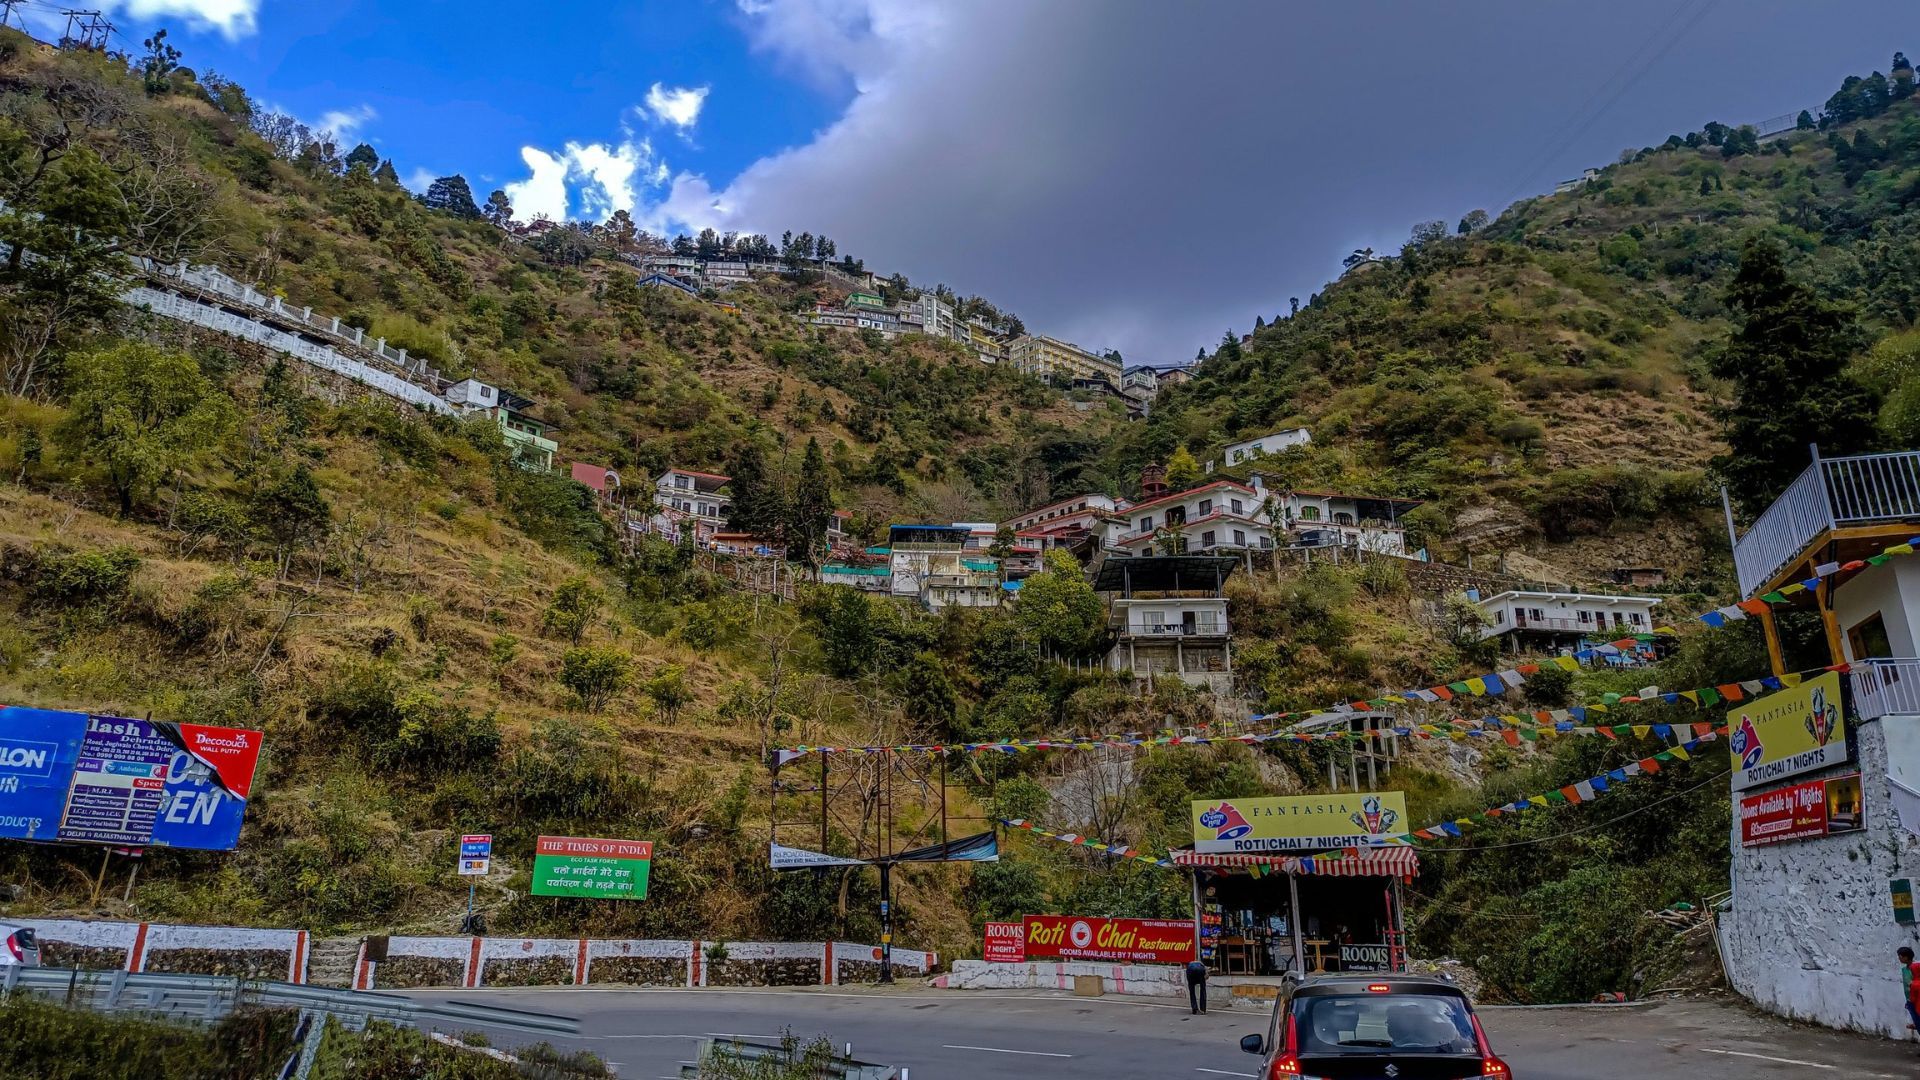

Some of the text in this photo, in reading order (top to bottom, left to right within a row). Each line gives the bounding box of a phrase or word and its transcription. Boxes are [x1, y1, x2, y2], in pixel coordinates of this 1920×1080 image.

[1756, 699, 1804, 725] FANTASIA
[87, 719, 140, 737] lash
[0, 747, 47, 768] LON
[220, 747, 242, 755] PUTTY
[1748, 748, 1825, 782] ROTI/CHAI 7 NIGHTS
[1253, 804, 1348, 817] FANTASIA
[542, 841, 647, 855] THE TIMES OF INDIA
[1234, 836, 1369, 850] ROTI/CHAI 7 NIGHTS
[583, 879, 593, 888] की
[987, 925, 1024, 938] ROOMS
[1028, 922, 1193, 951] Roti Chai Restaurant
[986, 945, 1017, 953] 7 NIGHTS
[1059, 948, 1082, 956] ROOMS
[1082, 950, 1116, 959] AVAILABLE
[1117, 951, 1127, 959] BY
[1132, 952, 1156, 960] NIGHTS
[1341, 946, 1389, 963] ROOMS
